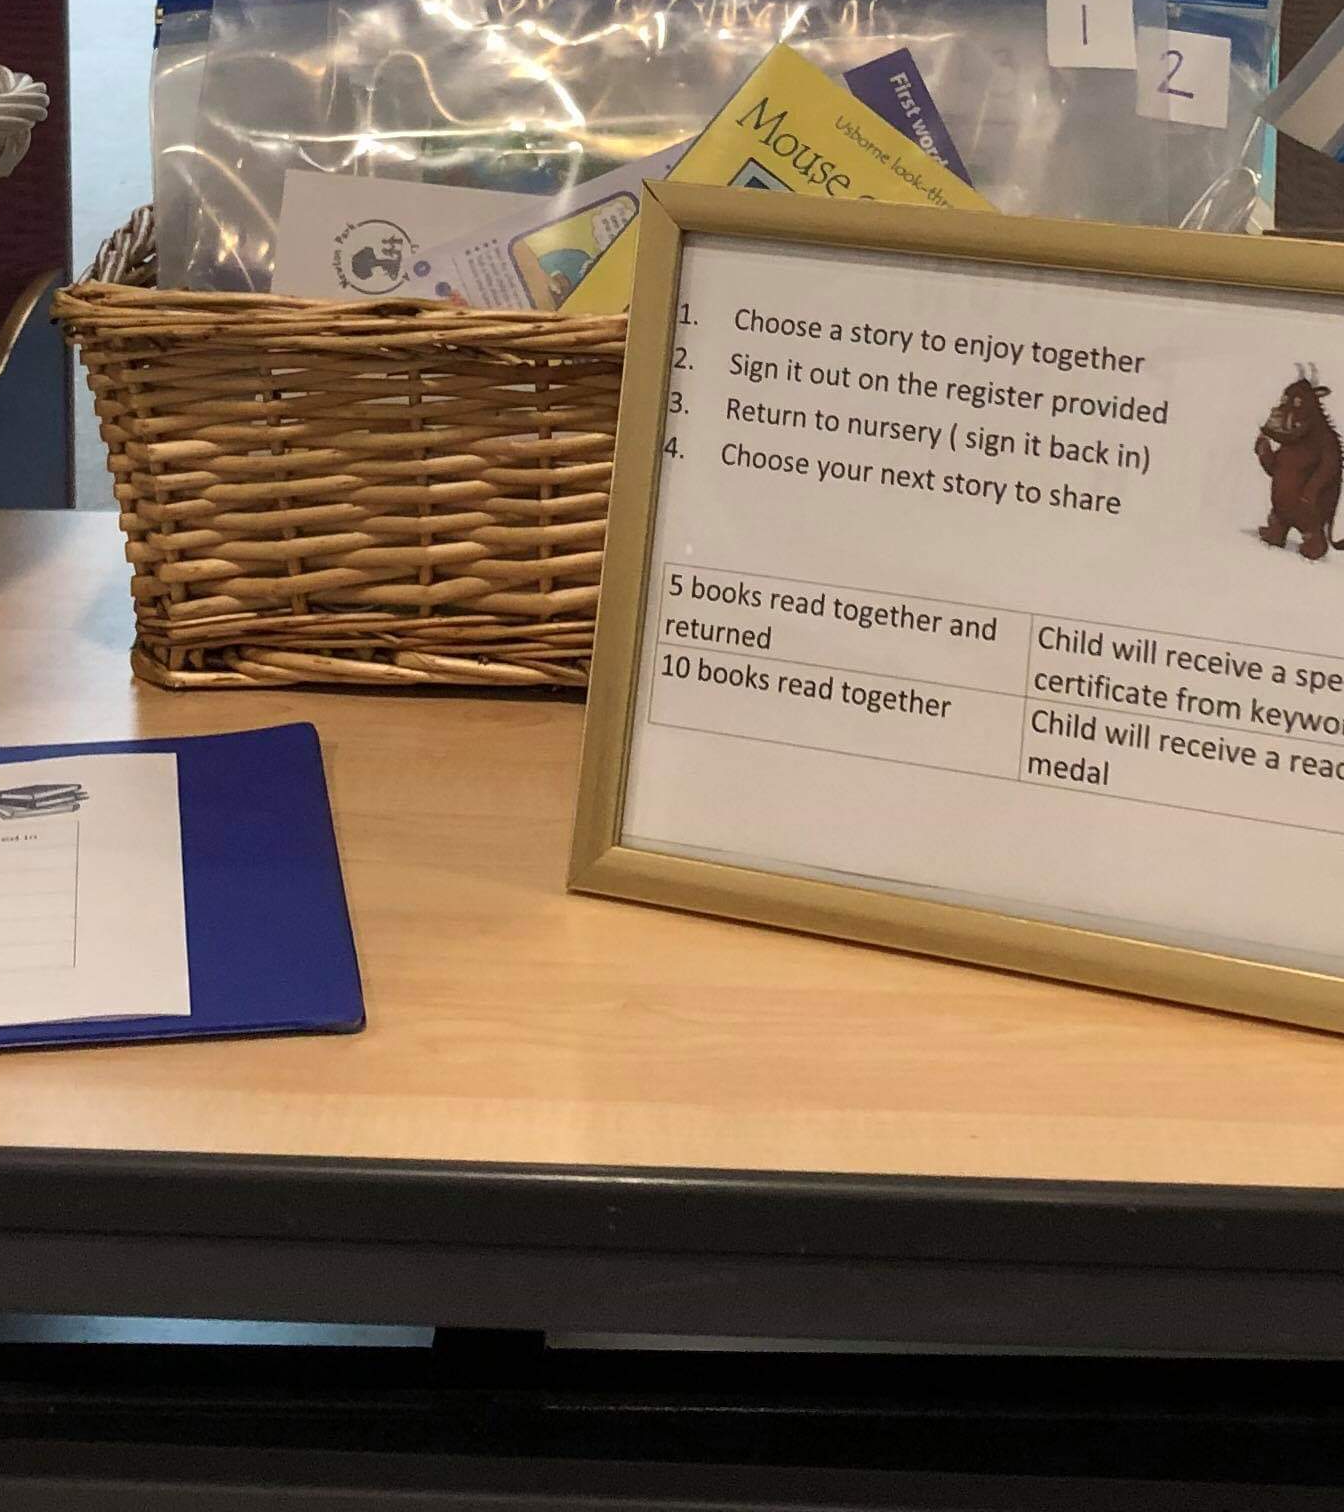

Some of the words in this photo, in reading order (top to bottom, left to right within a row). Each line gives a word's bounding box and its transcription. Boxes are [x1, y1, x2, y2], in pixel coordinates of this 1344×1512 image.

[889, 71, 925, 118] First
[1156, 48, 1195, 99] 2
[736, 96, 852, 197] Mouse
[834, 114, 891, 166] Usborne
[678, 302, 699, 326] 1.
[734, 308, 822, 339] Choose
[829, 323, 843, 342] a
[849, 323, 914, 354] story
[920, 329, 946, 352] to
[954, 334, 1025, 366] enjoy
[1031, 341, 1146, 374] together
[673, 347, 694, 372] 2.
[729, 352, 778, 384] Sign
[786, 358, 804, 383] it
[809, 366, 852, 389] out
[858, 372, 889, 393] on
[897, 371, 938, 398] the
[945, 381, 1045, 410] register
[1051, 394, 1169, 425] provided
[668, 391, 690, 416] 3.
[726, 397, 807, 429] Return
[814, 409, 840, 432] to
[847, 417, 943, 450] nursery
[964, 426, 1015, 458] sign
[1024, 431, 1042, 457] it
[1049, 434, 1110, 466] back
[1117, 443, 1150, 475] in)
[662, 435, 684, 460] 4.
[721, 442, 810, 475] Choose
[816, 459, 874, 483] your
[880, 467, 936, 492] next
[942, 472, 1008, 505] story
[1014, 480, 1042, 504] to
[1048, 483, 1122, 515] share
[665, 618, 772, 650] returned
[668, 573, 683, 597] 5
[691, 575, 762, 608] books
[770, 592, 826, 617] read
[833, 598, 943, 633] together
[949, 617, 997, 641] and
[661, 654, 691, 679] 10
[697, 658, 770, 691] books
[778, 675, 834, 701] read
[841, 681, 952, 718] together
[1038, 626, 1104, 657] Child
[1111, 638, 1157, 665] will
[1165, 649, 1264, 681] receive
[1271, 664, 1287, 685] a
[1034, 672, 1168, 713] certificate
[1175, 686, 1242, 721] from
[1031, 709, 1097, 742] Child
[1104, 723, 1151, 750] will
[1159, 734, 1257, 767] receive
[1264, 750, 1280, 770] a
[1028, 756, 1109, 786] medal
